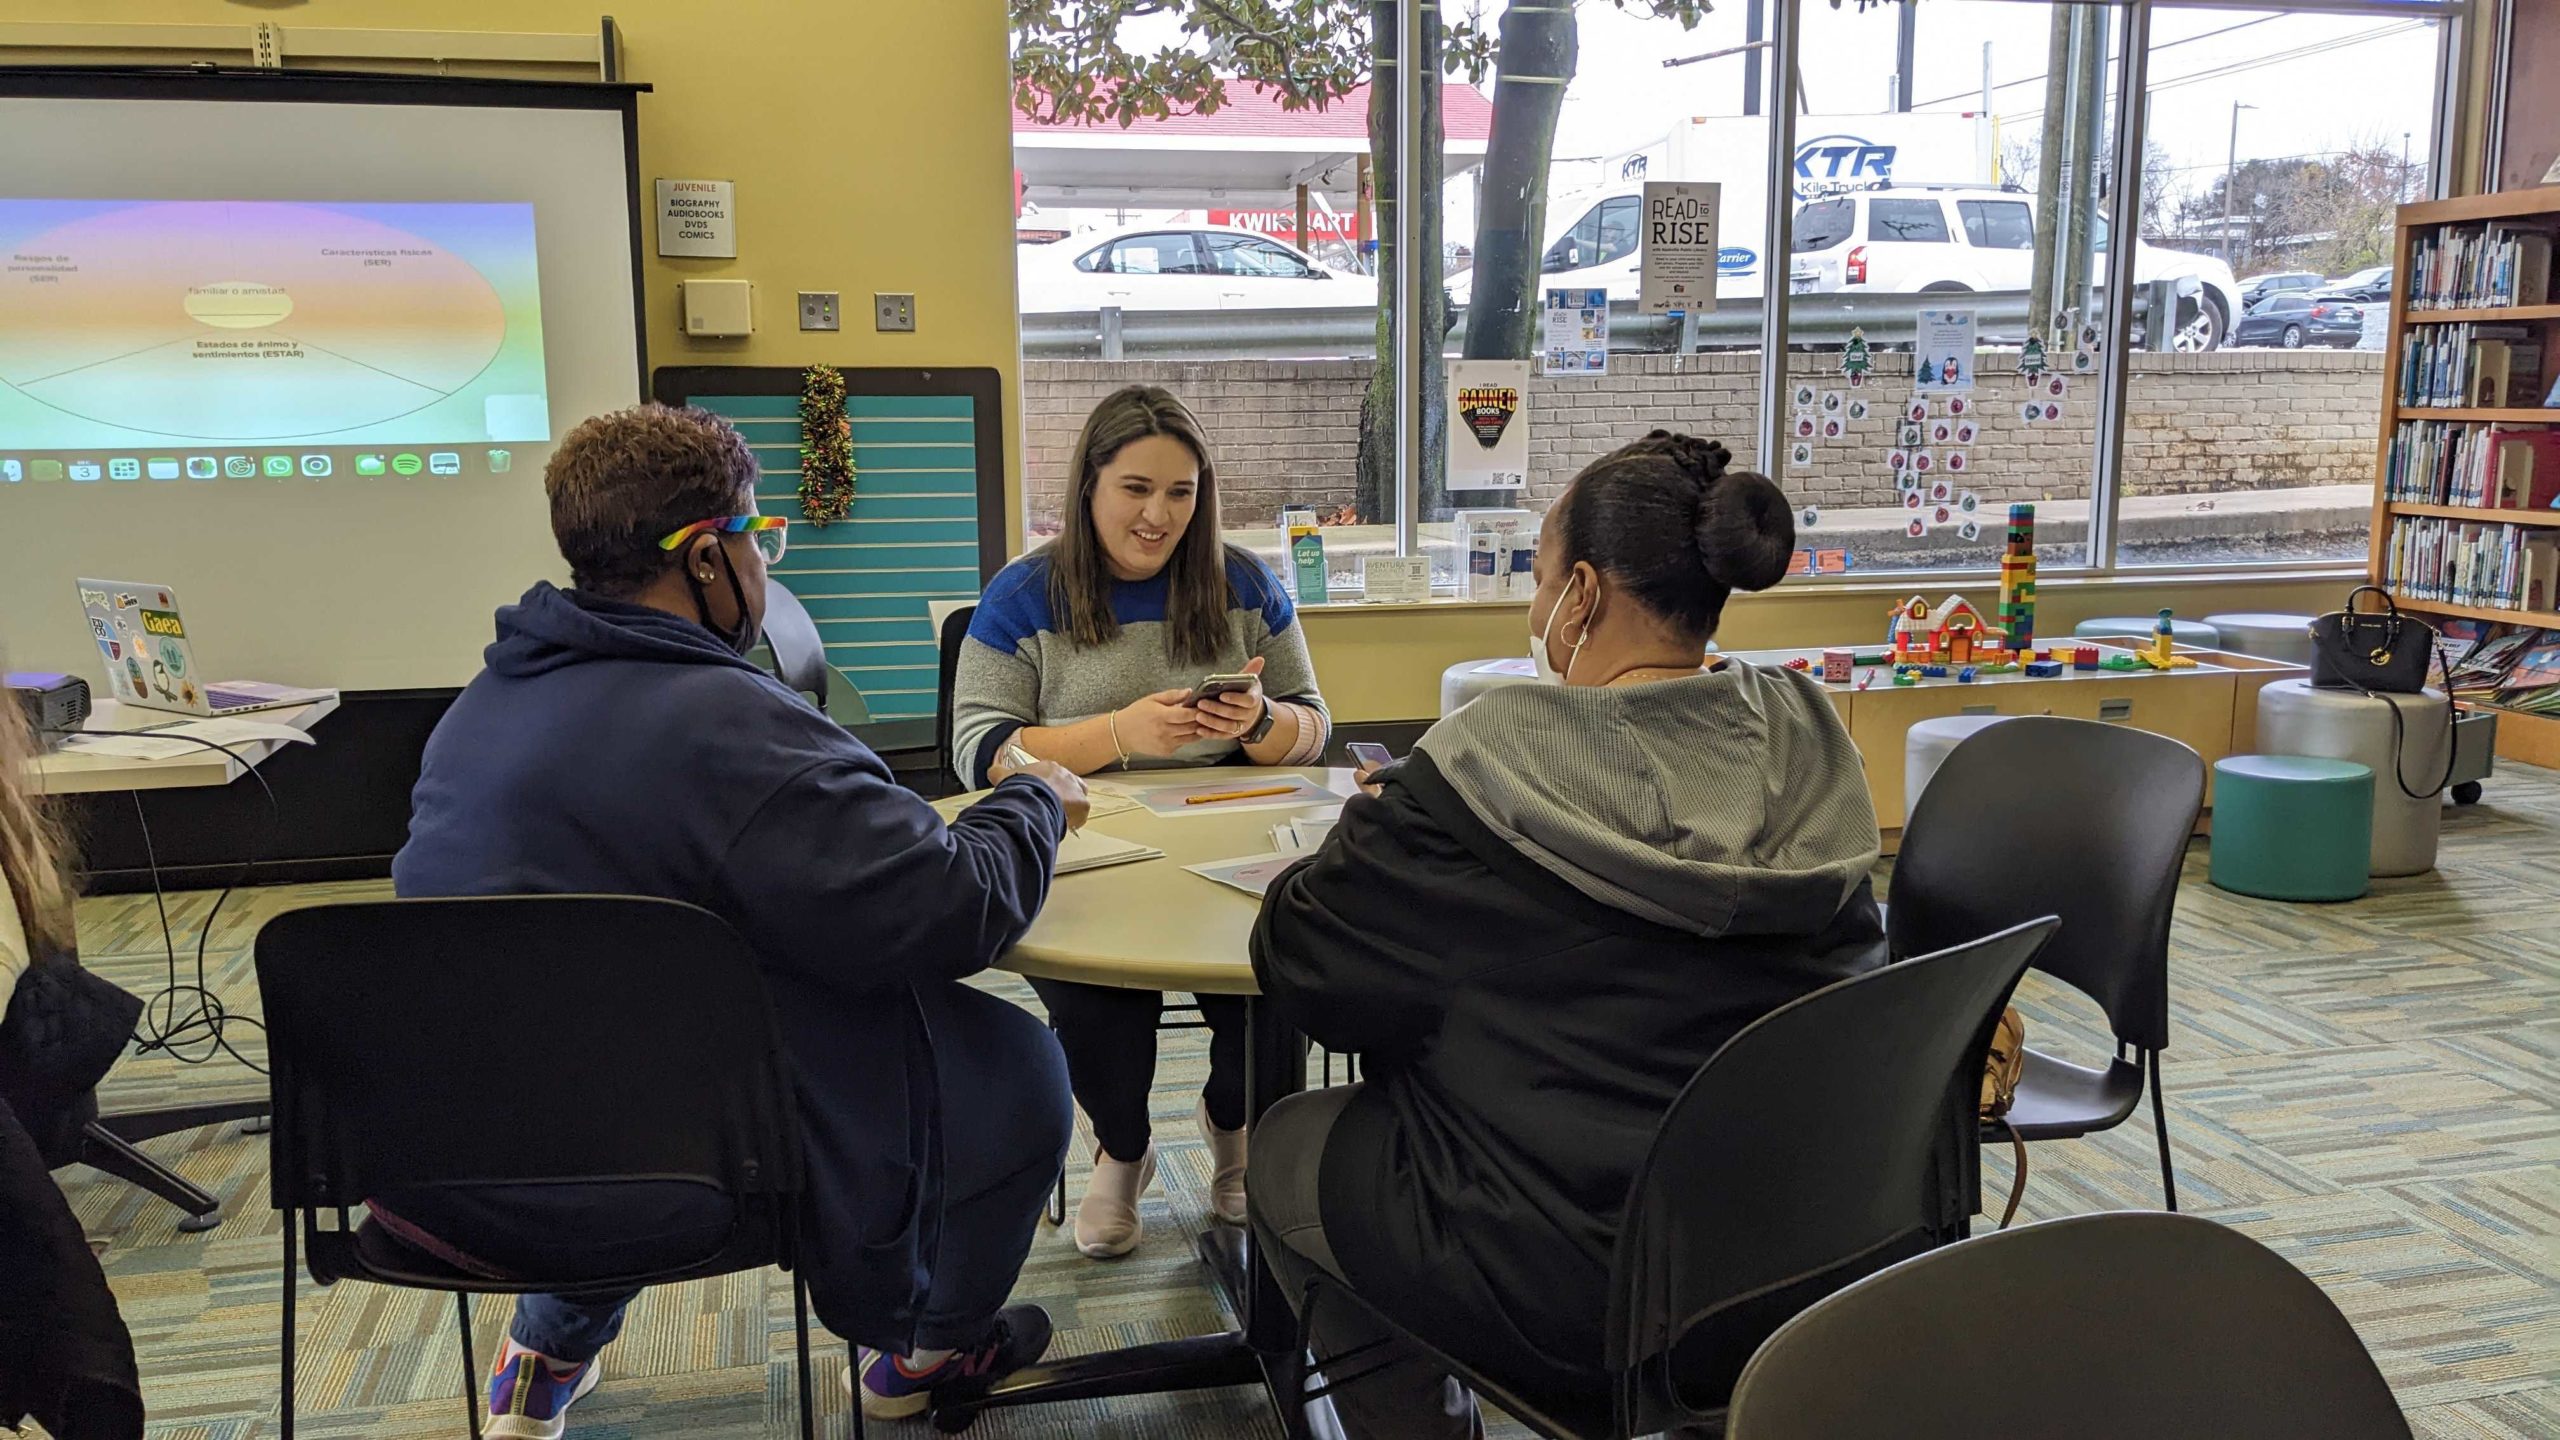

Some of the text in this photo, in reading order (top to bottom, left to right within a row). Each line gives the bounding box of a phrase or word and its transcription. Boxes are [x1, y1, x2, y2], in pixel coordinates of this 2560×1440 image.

[1622, 155, 1647, 178] KTR
[1794, 146, 1897, 177] KTR
[673, 183, 717, 193] JUVENILE
[1801, 182, 1828, 193] Kile
[670, 199, 720, 208] BIOGRAPHY
[1652, 197, 1698, 220] READ
[667, 209, 725, 219] AUDIOBOOKS
[684, 220, 708, 229] DVDS
[1229, 212, 1288, 232] KWIK
[678, 230, 715, 239] COMICS
[1652, 222, 1710, 245] RISE
[196, 341, 238, 349] Estados
[240, 341, 254, 349] de
[192, 350, 305, 359] sentimientos (ESTAR)
[1459, 388, 1517, 412] BANNED
[1476, 407, 1500, 415] BOOKS
[79, 467, 91, 478] 3
[1365, 561, 1405, 569] AVENTURA
[92, 618, 104, 628] ED
[142, 611, 182, 634] Gaea
